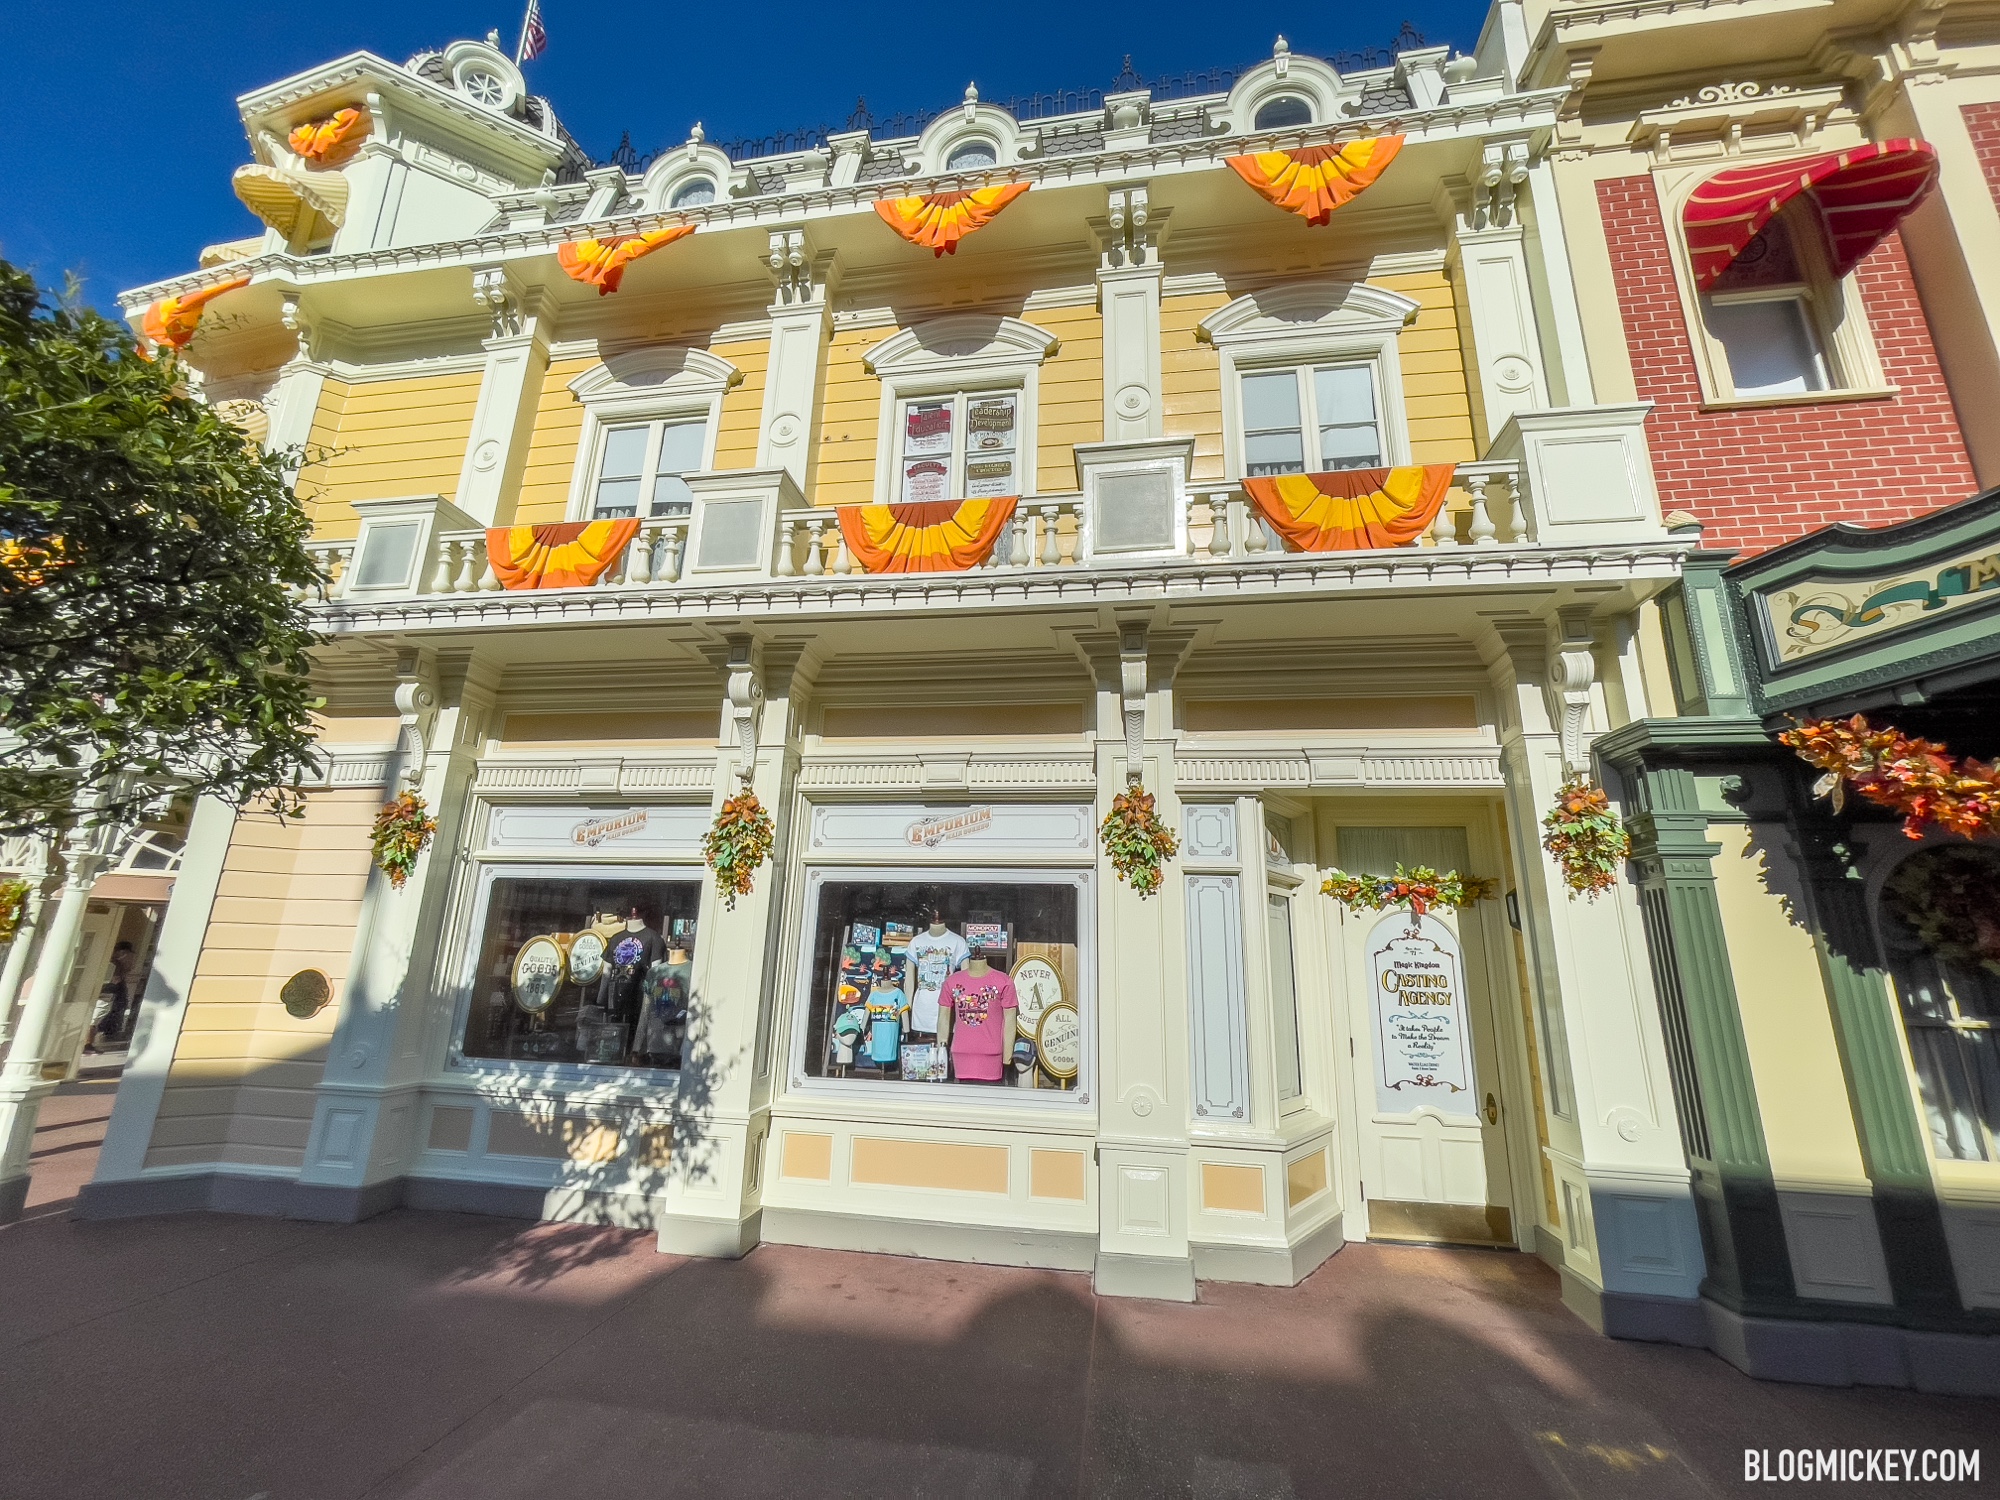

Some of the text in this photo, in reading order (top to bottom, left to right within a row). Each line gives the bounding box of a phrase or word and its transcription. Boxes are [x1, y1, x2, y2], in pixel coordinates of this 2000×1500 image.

[972, 405, 1012, 418] Leadership
[912, 421, 948, 435] Education
[971, 418, 1012, 430] Development
[576, 809, 648, 842] EMPORIUM
[911, 807, 992, 842] EMPORIUM
[573, 953, 600, 971] GENUINE
[1394, 961, 1441, 970] Magic Kingdom
[522, 963, 557, 977] GOODS
[1020, 969, 1051, 981] NEVER
[1382, 969, 1448, 993] CASTING
[1028, 982, 1045, 1010] A
[1398, 990, 1452, 1006] AGENCY
[1055, 1014, 1072, 1022] ALL
[1421, 1024, 1443, 1034] People
[1427, 1033, 1450, 1041] Dream
[1053, 1055, 1075, 1063] GOODS
